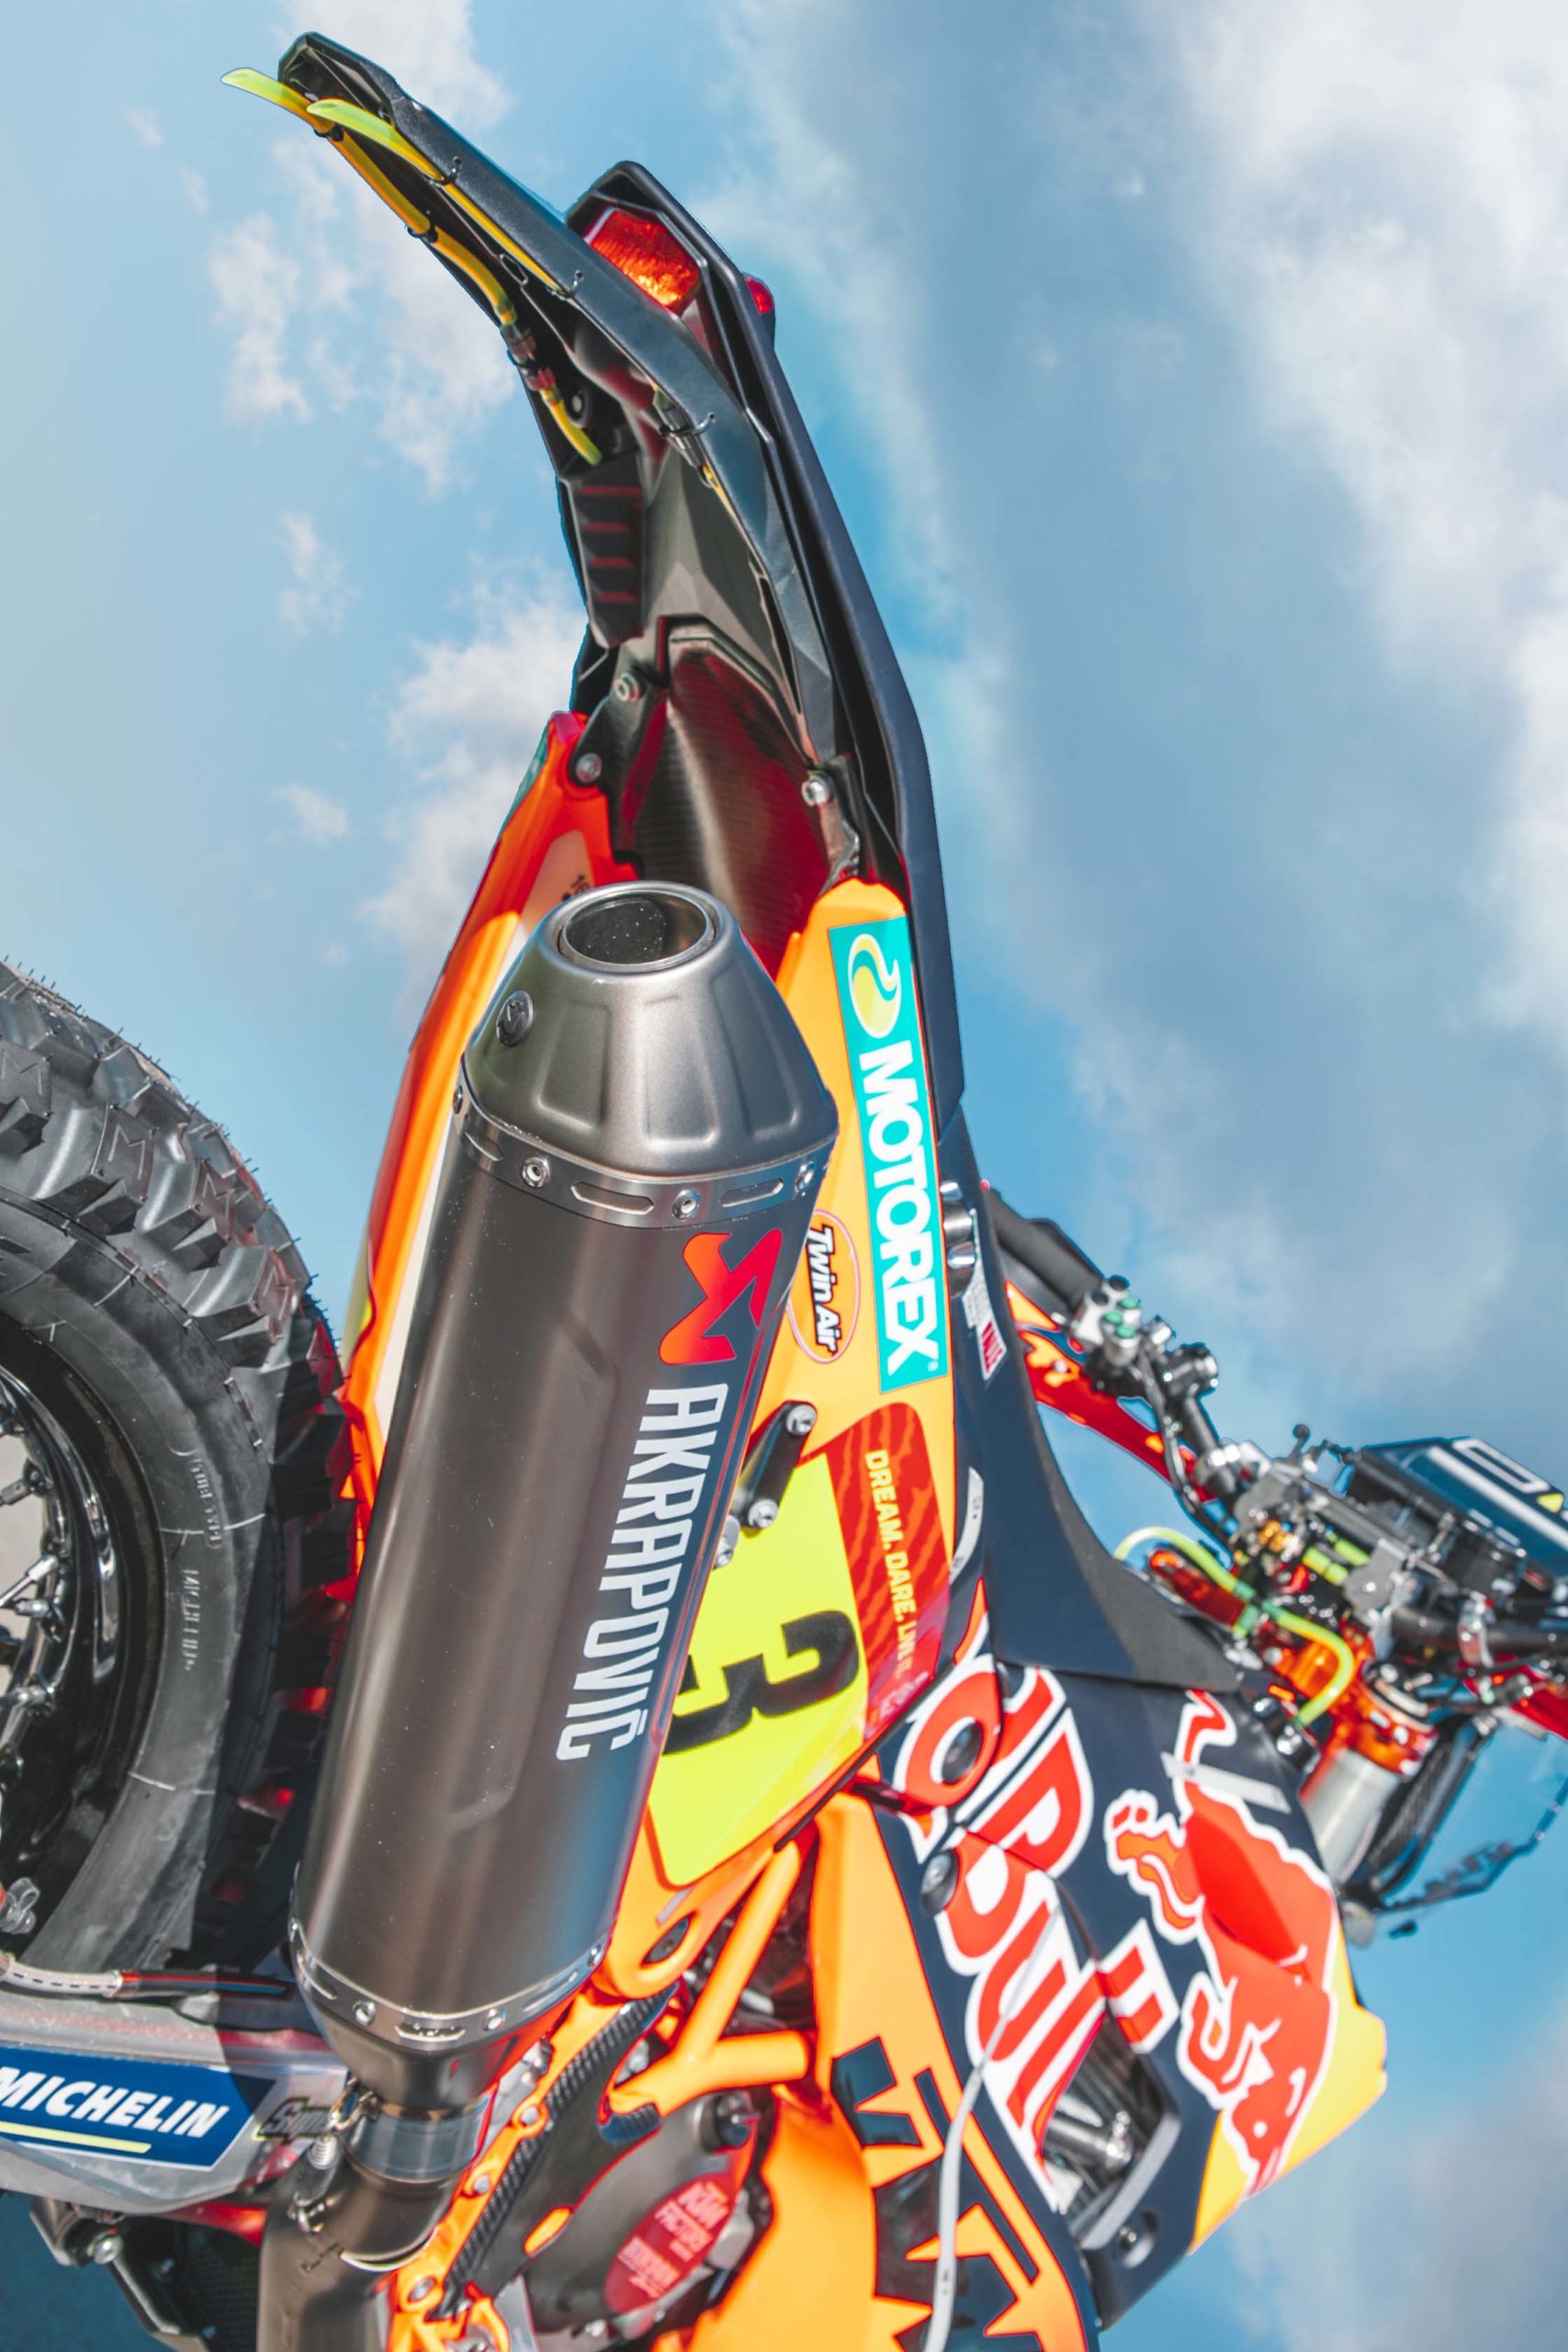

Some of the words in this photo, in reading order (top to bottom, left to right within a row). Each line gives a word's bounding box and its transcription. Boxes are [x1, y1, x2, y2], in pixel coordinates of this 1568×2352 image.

[806, 1223, 837, 1304] Twin
[860, 1040, 940, 1376] MOTOREX
[816, 1305, 841, 1353] Air
[556, 1382, 729, 1761] AKRAPOVIČ
[865, 1449, 904, 1551] DREAM.
[885, 1550, 917, 1623] DARE.
[0, 2066, 229, 2139] MICHELIN
